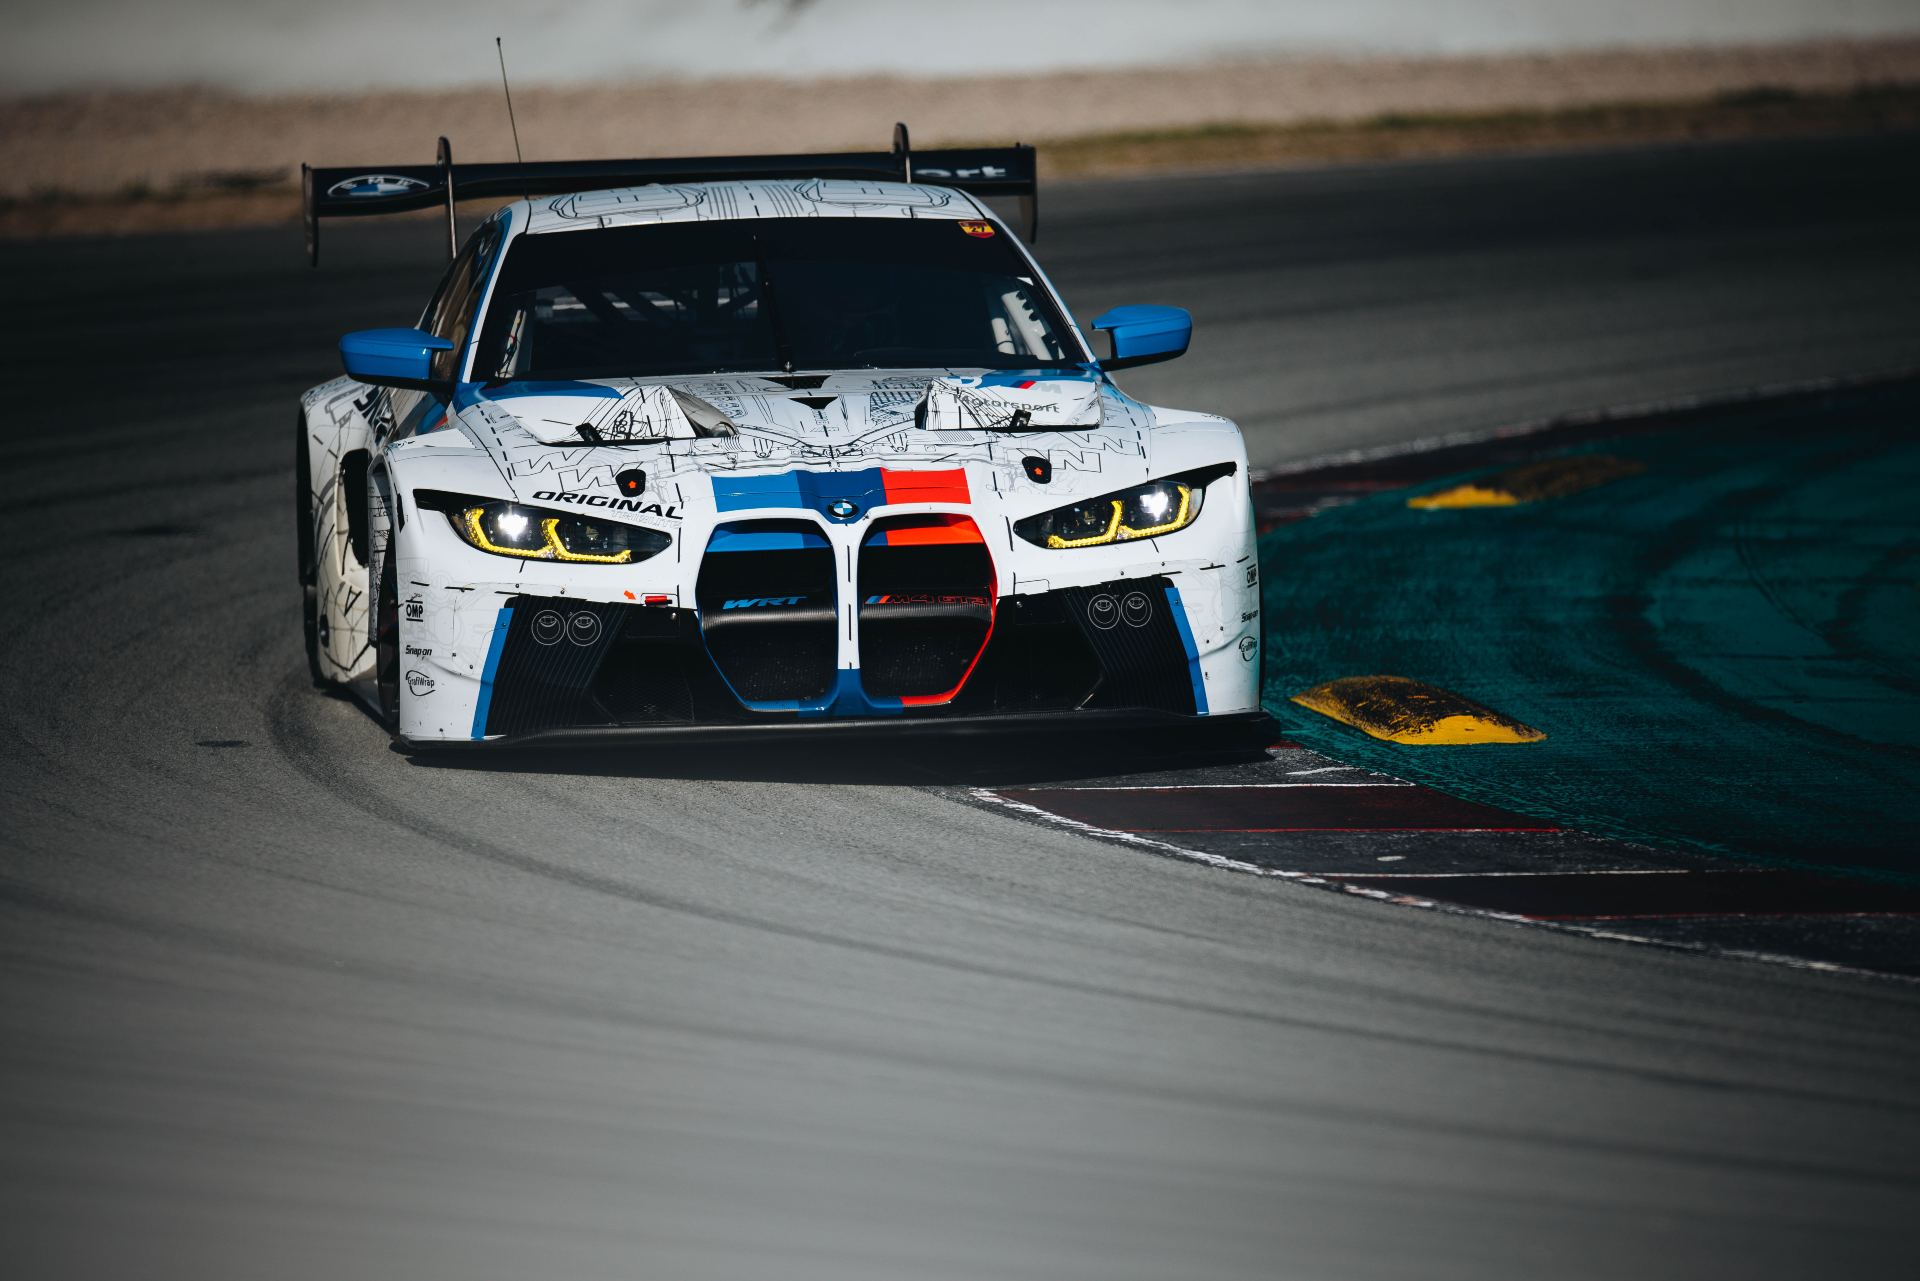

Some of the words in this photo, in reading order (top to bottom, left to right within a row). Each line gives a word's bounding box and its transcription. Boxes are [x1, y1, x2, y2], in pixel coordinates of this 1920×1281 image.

[532, 490, 684, 520] ORIGINAL
[722, 596, 808, 610] WRT
[406, 604, 424, 618] OMP
